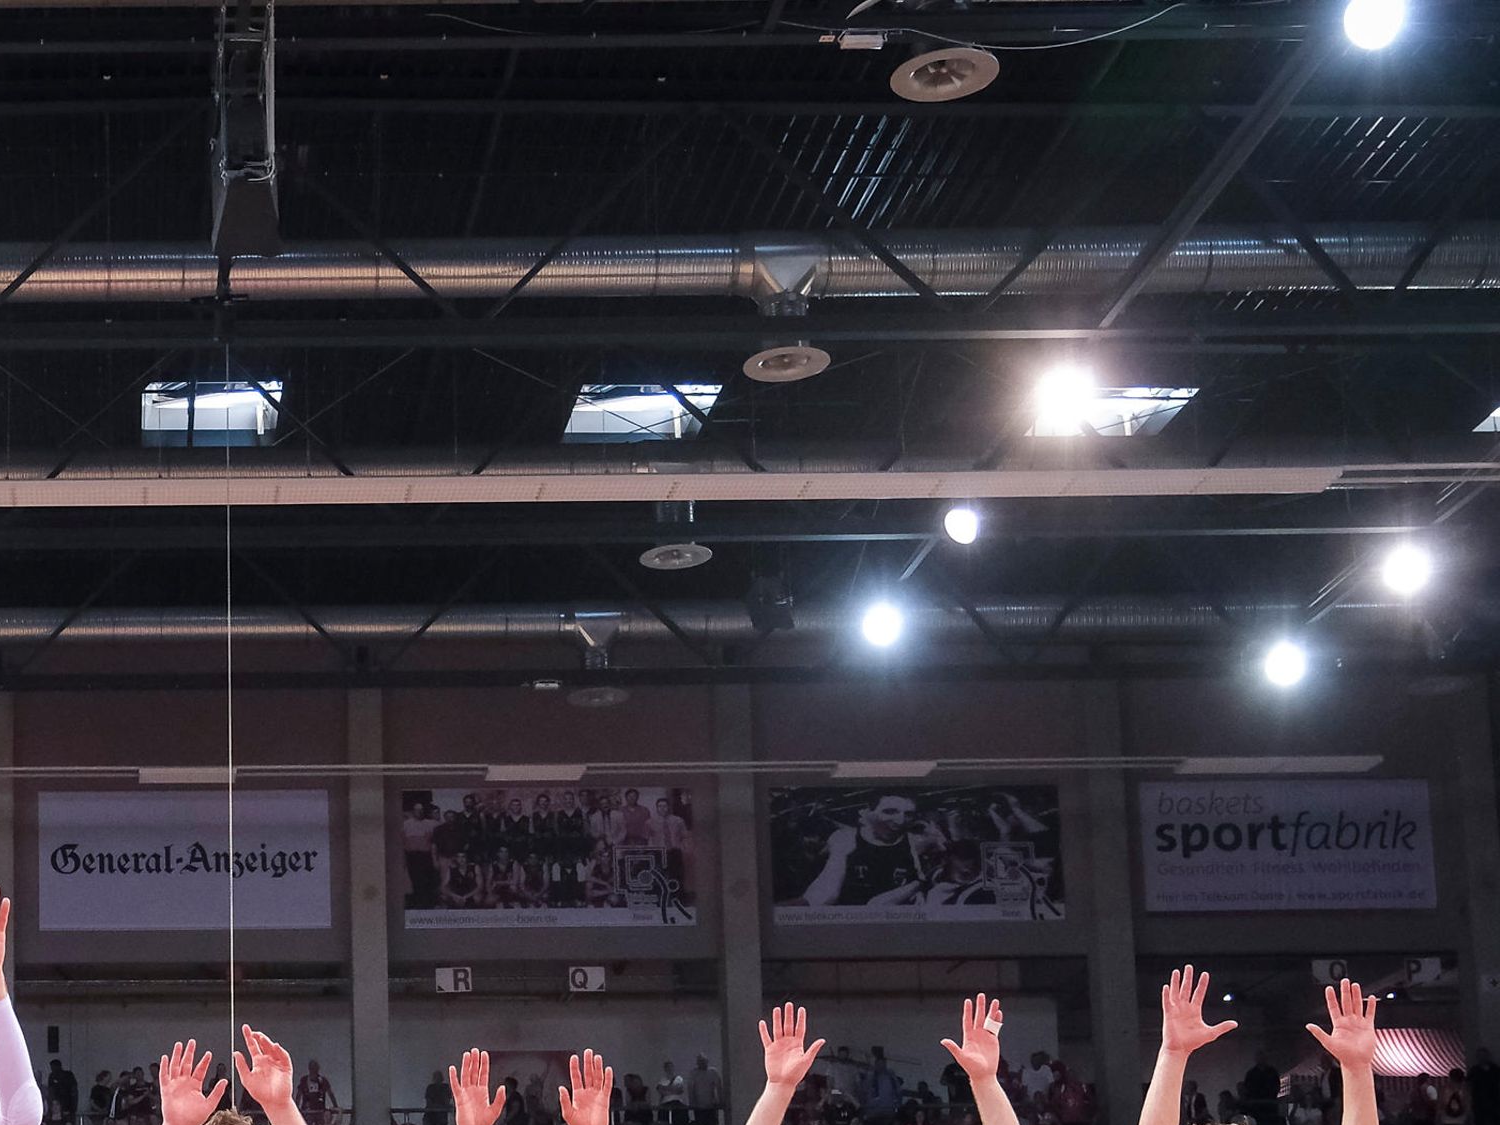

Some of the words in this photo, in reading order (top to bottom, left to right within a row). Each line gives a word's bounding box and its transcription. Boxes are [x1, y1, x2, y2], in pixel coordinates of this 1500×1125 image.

[1157, 791, 1264, 817] baskets
[1155, 809, 1417, 858] sportfabrik
[50, 841, 319, 878] General-Anzeiger
[453, 968, 471, 991] R
[570, 968, 589, 990] Q
